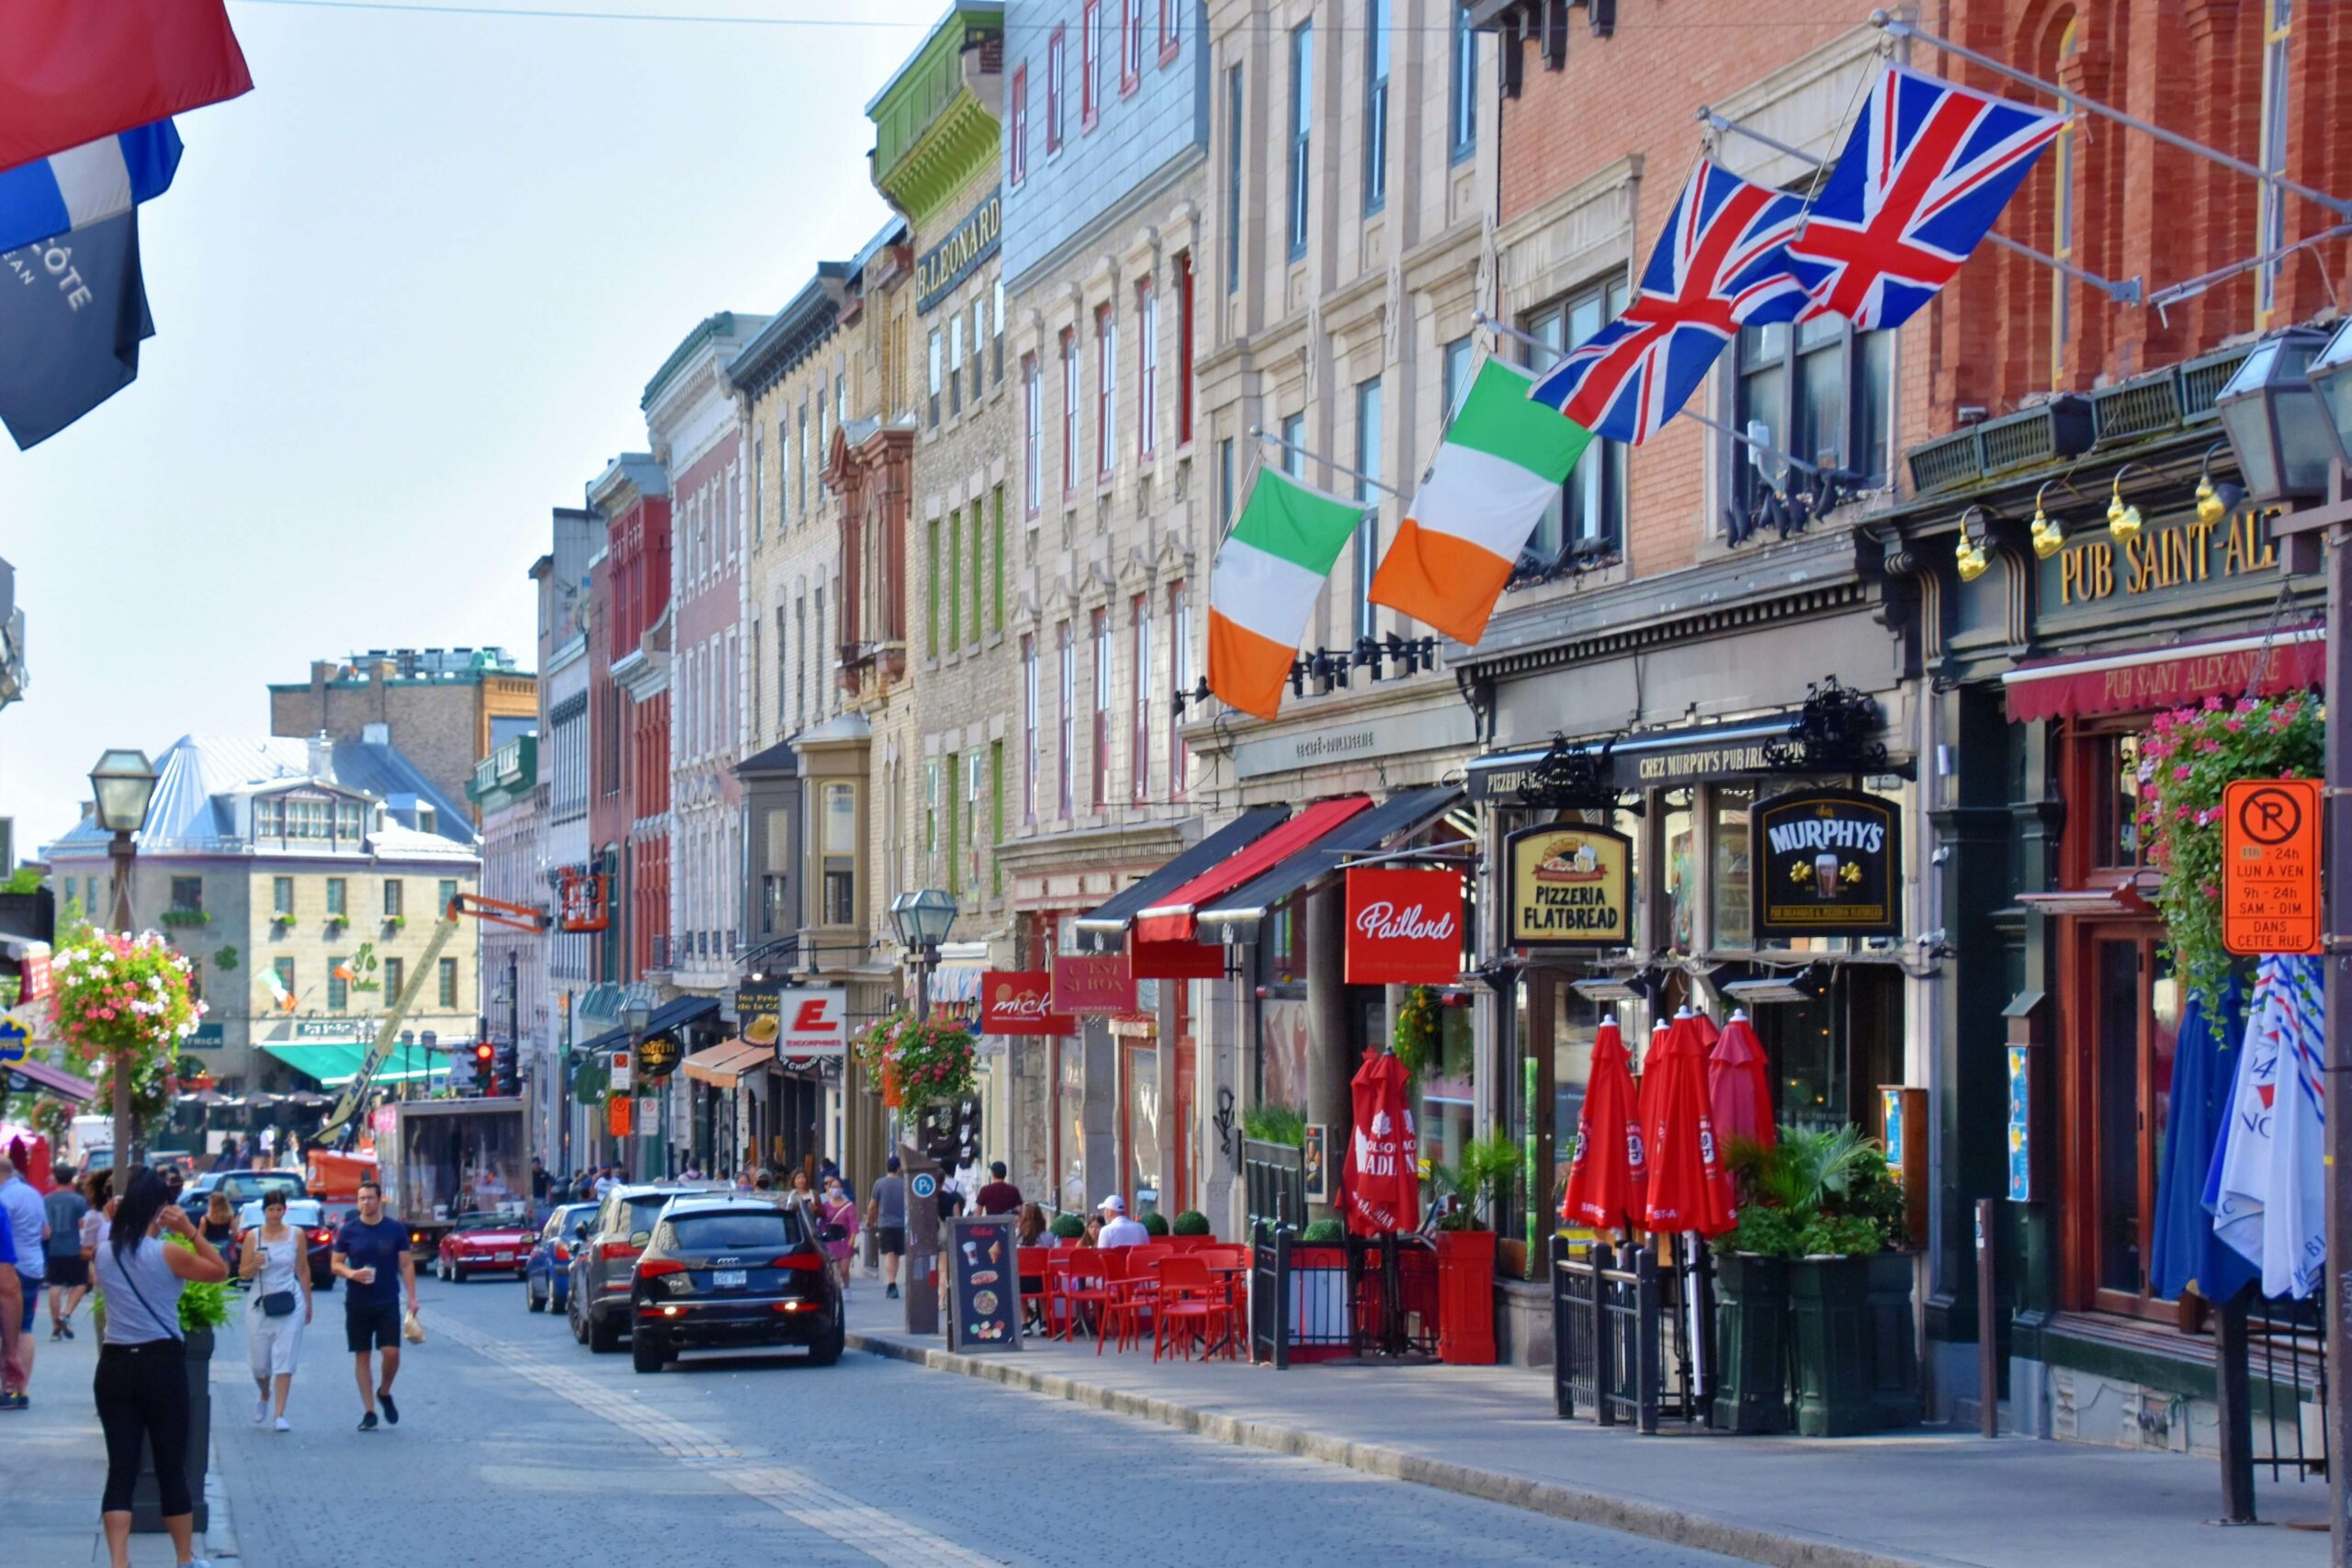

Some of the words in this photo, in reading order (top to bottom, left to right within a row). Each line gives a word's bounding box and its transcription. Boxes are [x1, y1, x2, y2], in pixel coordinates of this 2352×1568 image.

[2061, 541, 2113, 604] PUB
[2104, 668, 2132, 700] PUB
[2137, 662, 2180, 697] SAINT
[2185, 649, 2280, 691] ALEXANDRE
[1640, 754, 1666, 779] CHEZ
[1668, 750, 1720, 774] MURPHY'S
[1723, 749, 1744, 772] PUB
[2243, 847, 2261, 859] 11h
[2276, 848, 2300, 860] 24h
[2237, 865, 2261, 877] LUN
[2267, 863, 2276, 877] À
[2279, 865, 2303, 877] VEN
[1535, 886, 1605, 905] PIZZERIA
[2244, 887, 2259, 898] 9h
[2273, 887, 2297, 898] 24h
[2240, 903, 2265, 915] SAM
[2279, 903, 2301, 914] DIM
[1356, 901, 1455, 940] Paillard
[1523, 906, 1619, 930] FLATBREAD
[2254, 921, 2286, 932] DANS
[2238, 935, 2271, 947] CETTE
[2278, 935, 2302, 947] RUE
